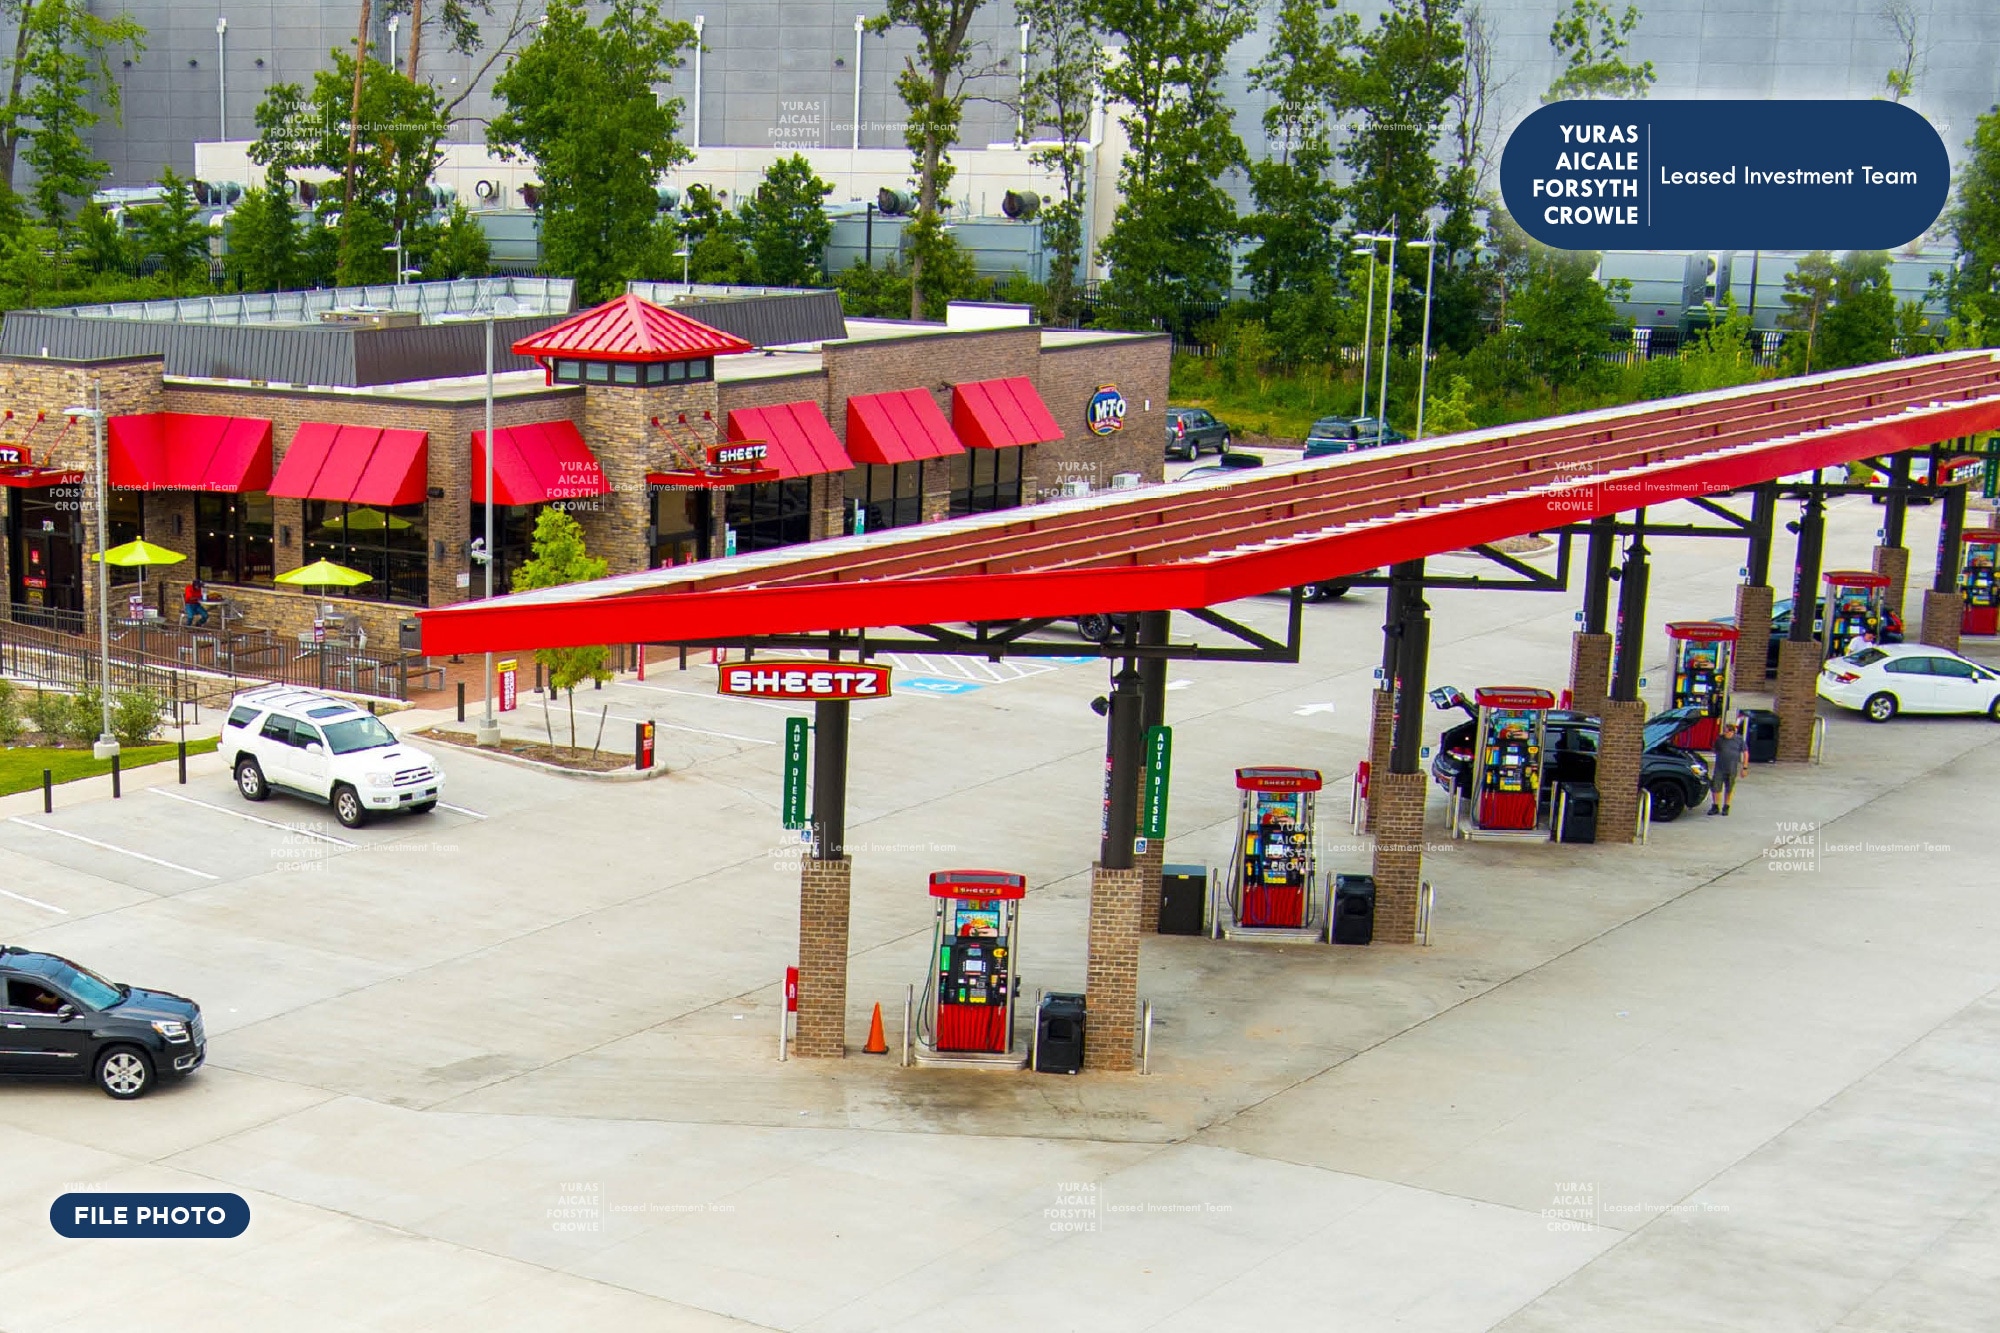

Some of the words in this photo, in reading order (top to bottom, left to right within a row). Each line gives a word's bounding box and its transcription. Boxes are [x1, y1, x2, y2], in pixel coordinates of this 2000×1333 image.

[720, 445, 767, 463] SHEETZ
[730, 670, 877, 694] SHEETZ
[1156, 733, 1164, 770] AUTO
[790, 768, 798, 824] DIESEL
[1152, 776, 1160, 832] DIESEL
